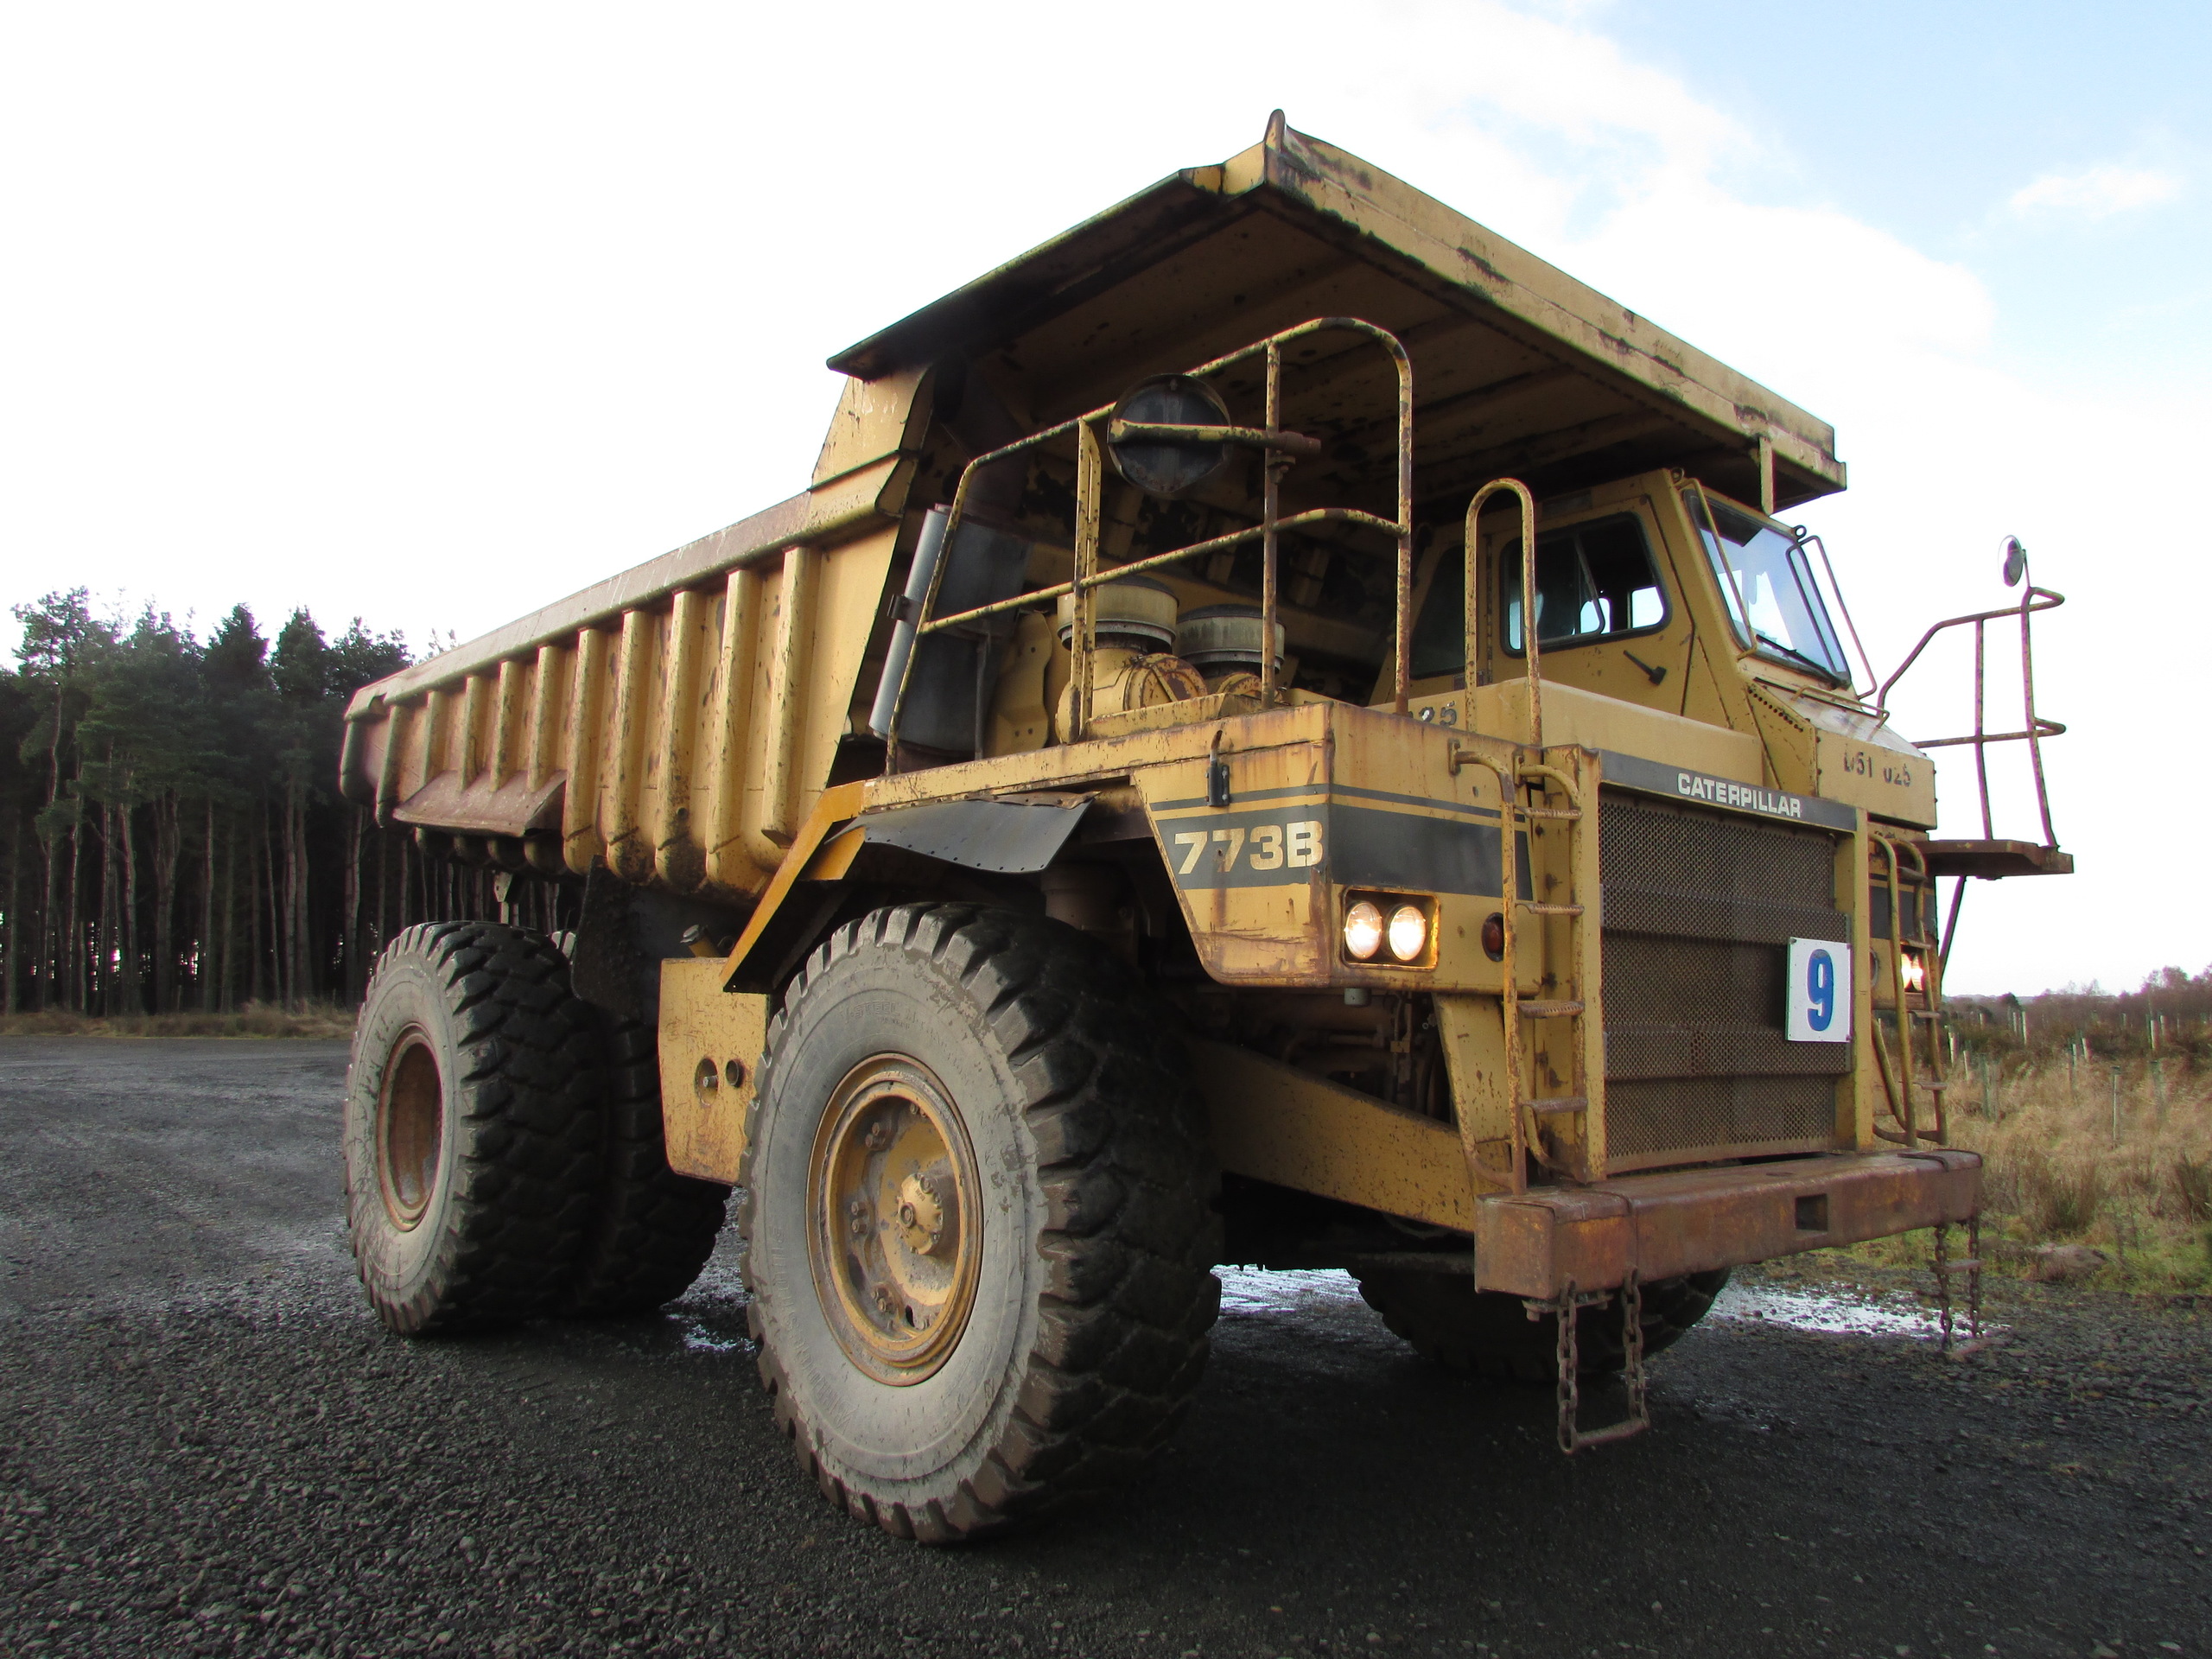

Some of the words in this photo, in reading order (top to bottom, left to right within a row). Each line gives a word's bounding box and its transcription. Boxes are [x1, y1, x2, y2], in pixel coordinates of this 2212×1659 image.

[1677, 772, 1801, 818] CATERPILLAR
[1174, 820, 1324, 875] 773B
[1807, 949, 1834, 1032] 9
